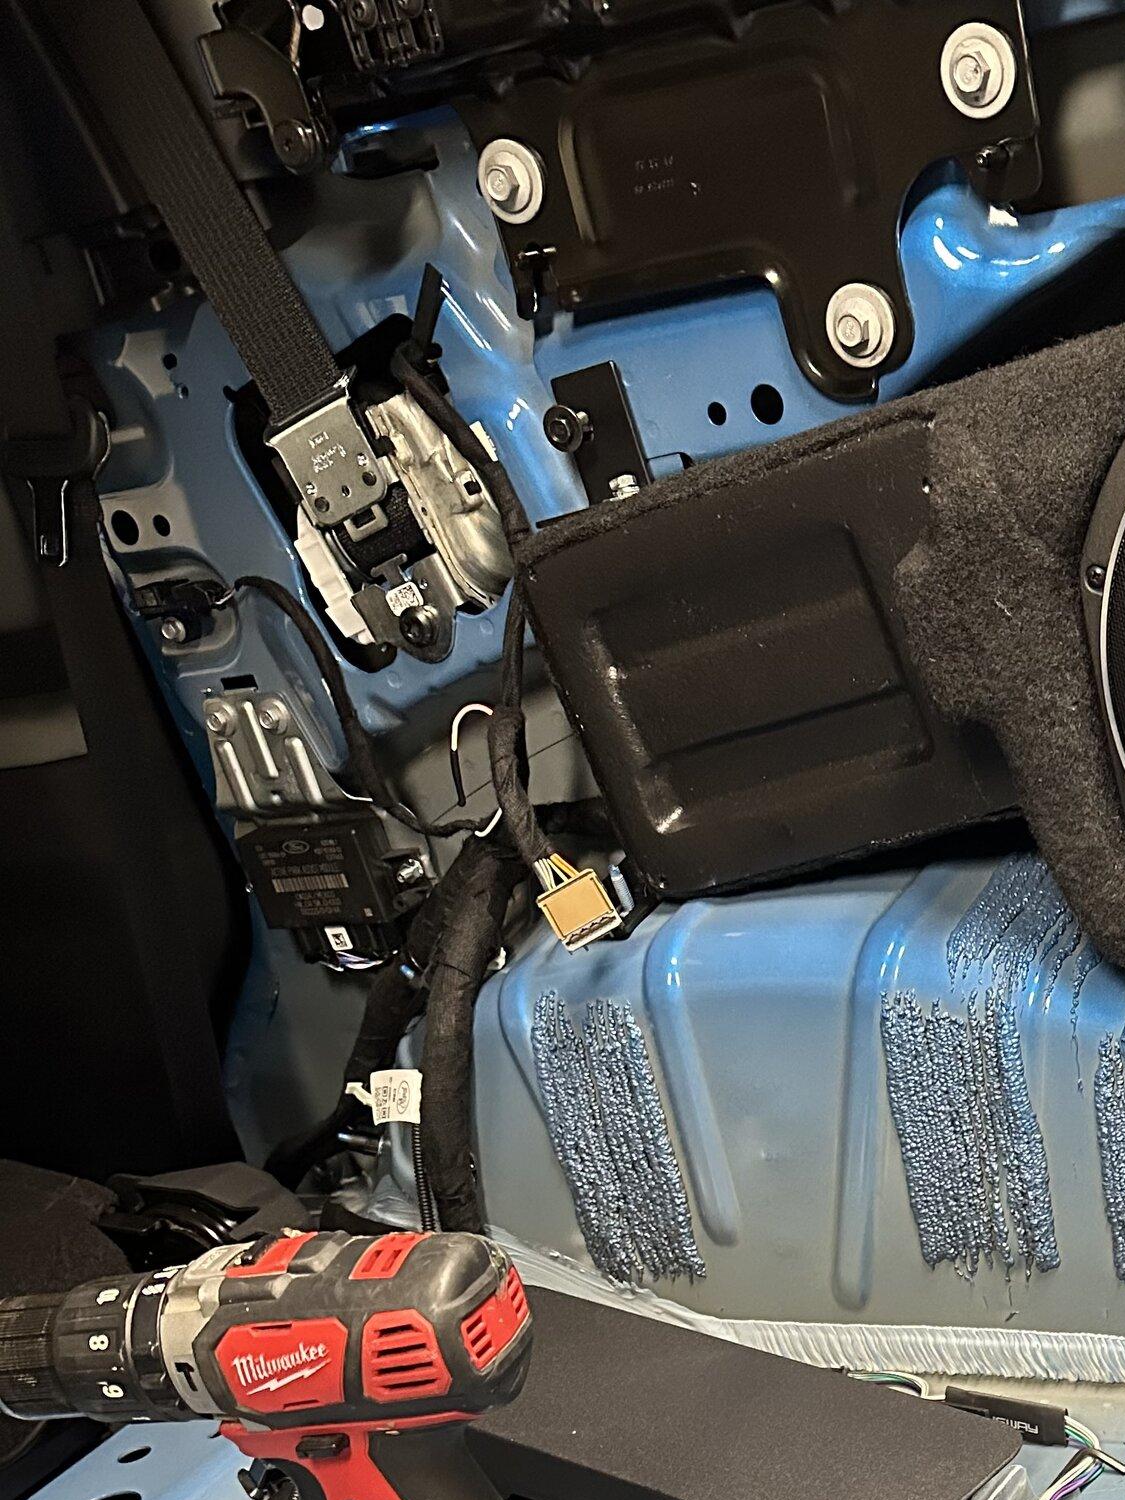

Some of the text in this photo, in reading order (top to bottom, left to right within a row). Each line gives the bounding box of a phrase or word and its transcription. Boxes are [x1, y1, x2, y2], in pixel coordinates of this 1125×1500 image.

[88, 1334, 109, 1351] 8
[232, 1341, 329, 1387] Milwaukee
[992, 1416, 1039, 1434] SWAY
